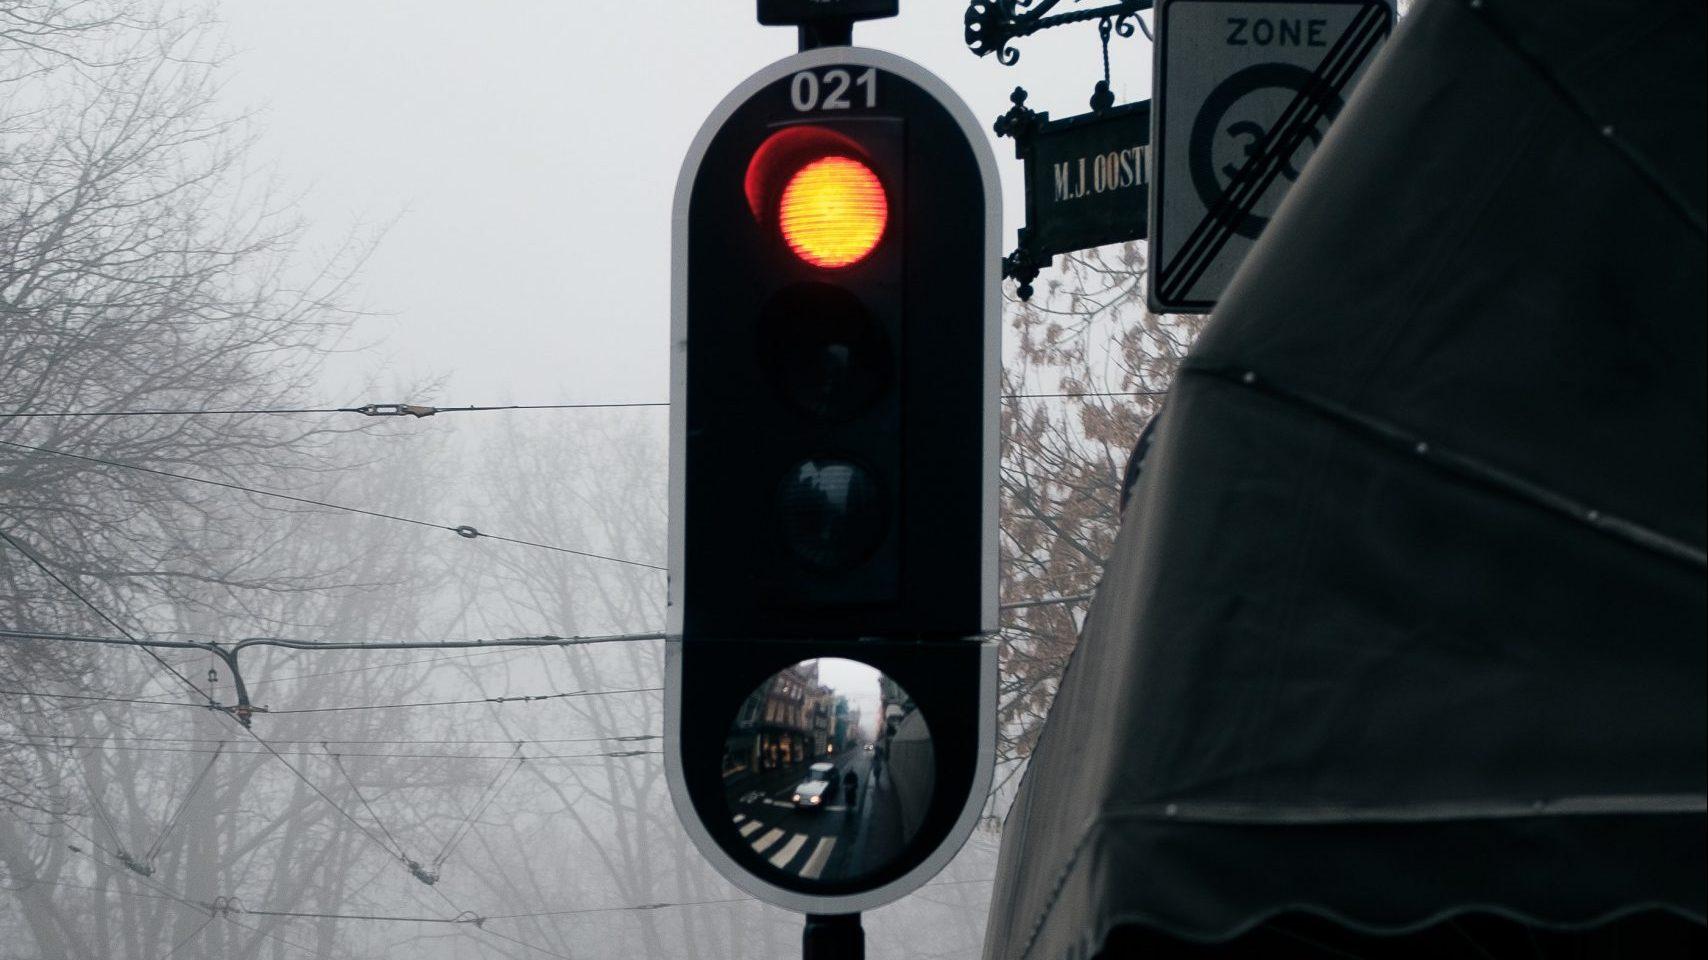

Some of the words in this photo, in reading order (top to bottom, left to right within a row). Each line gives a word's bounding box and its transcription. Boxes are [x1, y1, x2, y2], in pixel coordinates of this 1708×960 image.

[1226, 18, 1328, 46] ZONE
[791, 67, 876, 112] 021
[1093, 144, 1148, 194] OOST
